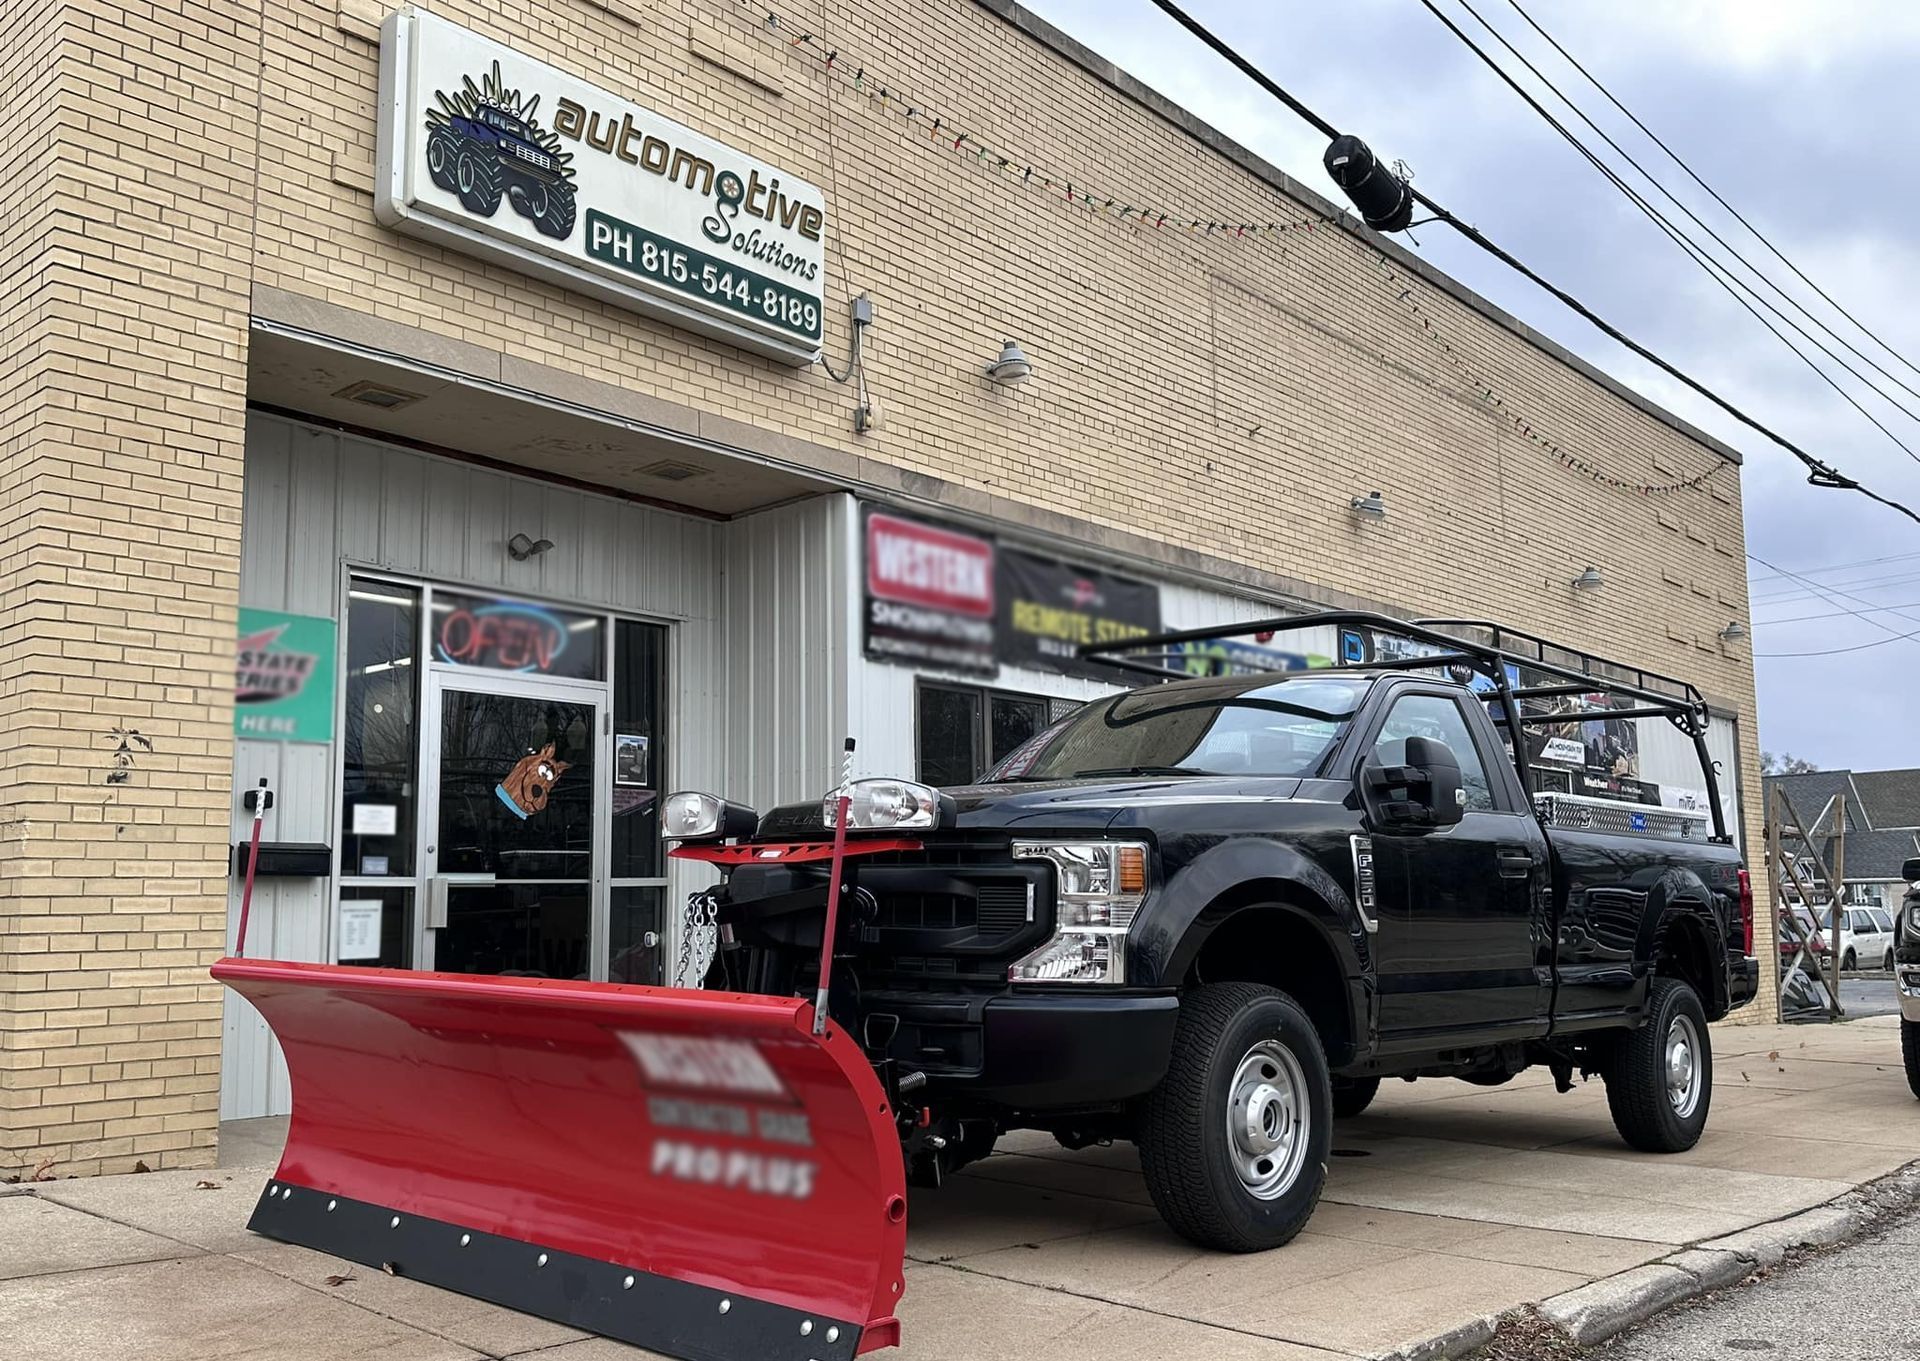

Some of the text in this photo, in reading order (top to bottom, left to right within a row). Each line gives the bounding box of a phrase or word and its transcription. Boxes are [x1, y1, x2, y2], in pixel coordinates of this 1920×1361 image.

[552, 95, 823, 242] automotive
[592, 220, 819, 332] PH 815-544-8189
[701, 198, 819, 281] Solutions
[441, 609, 557, 670] OPEN
